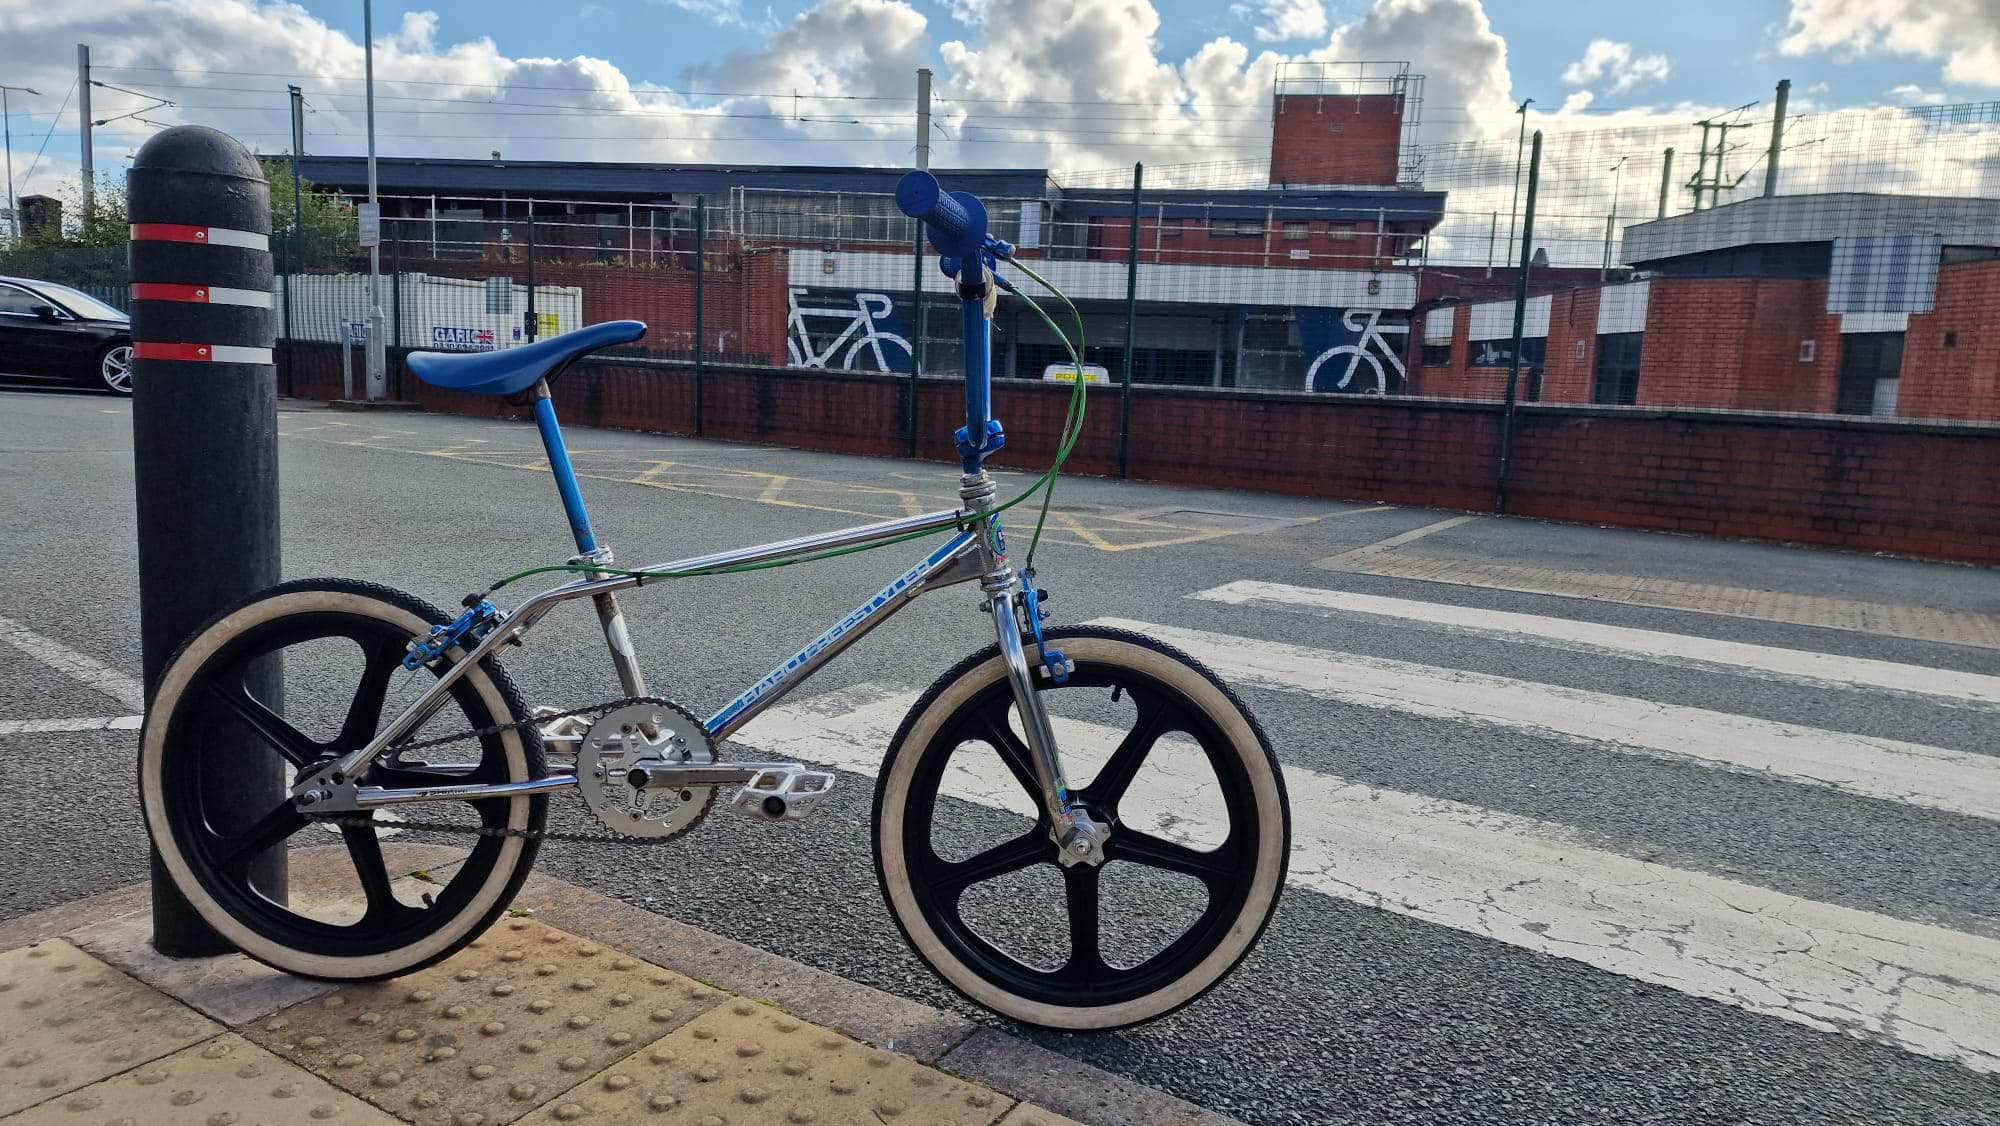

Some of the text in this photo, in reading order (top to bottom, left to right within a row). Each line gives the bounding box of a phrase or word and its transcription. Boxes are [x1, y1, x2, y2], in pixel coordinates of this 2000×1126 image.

[434, 328, 482, 343] GARIC
[1056, 373, 1097, 382] POLCE
[741, 560, 931, 705] HARO FREESTYLER
